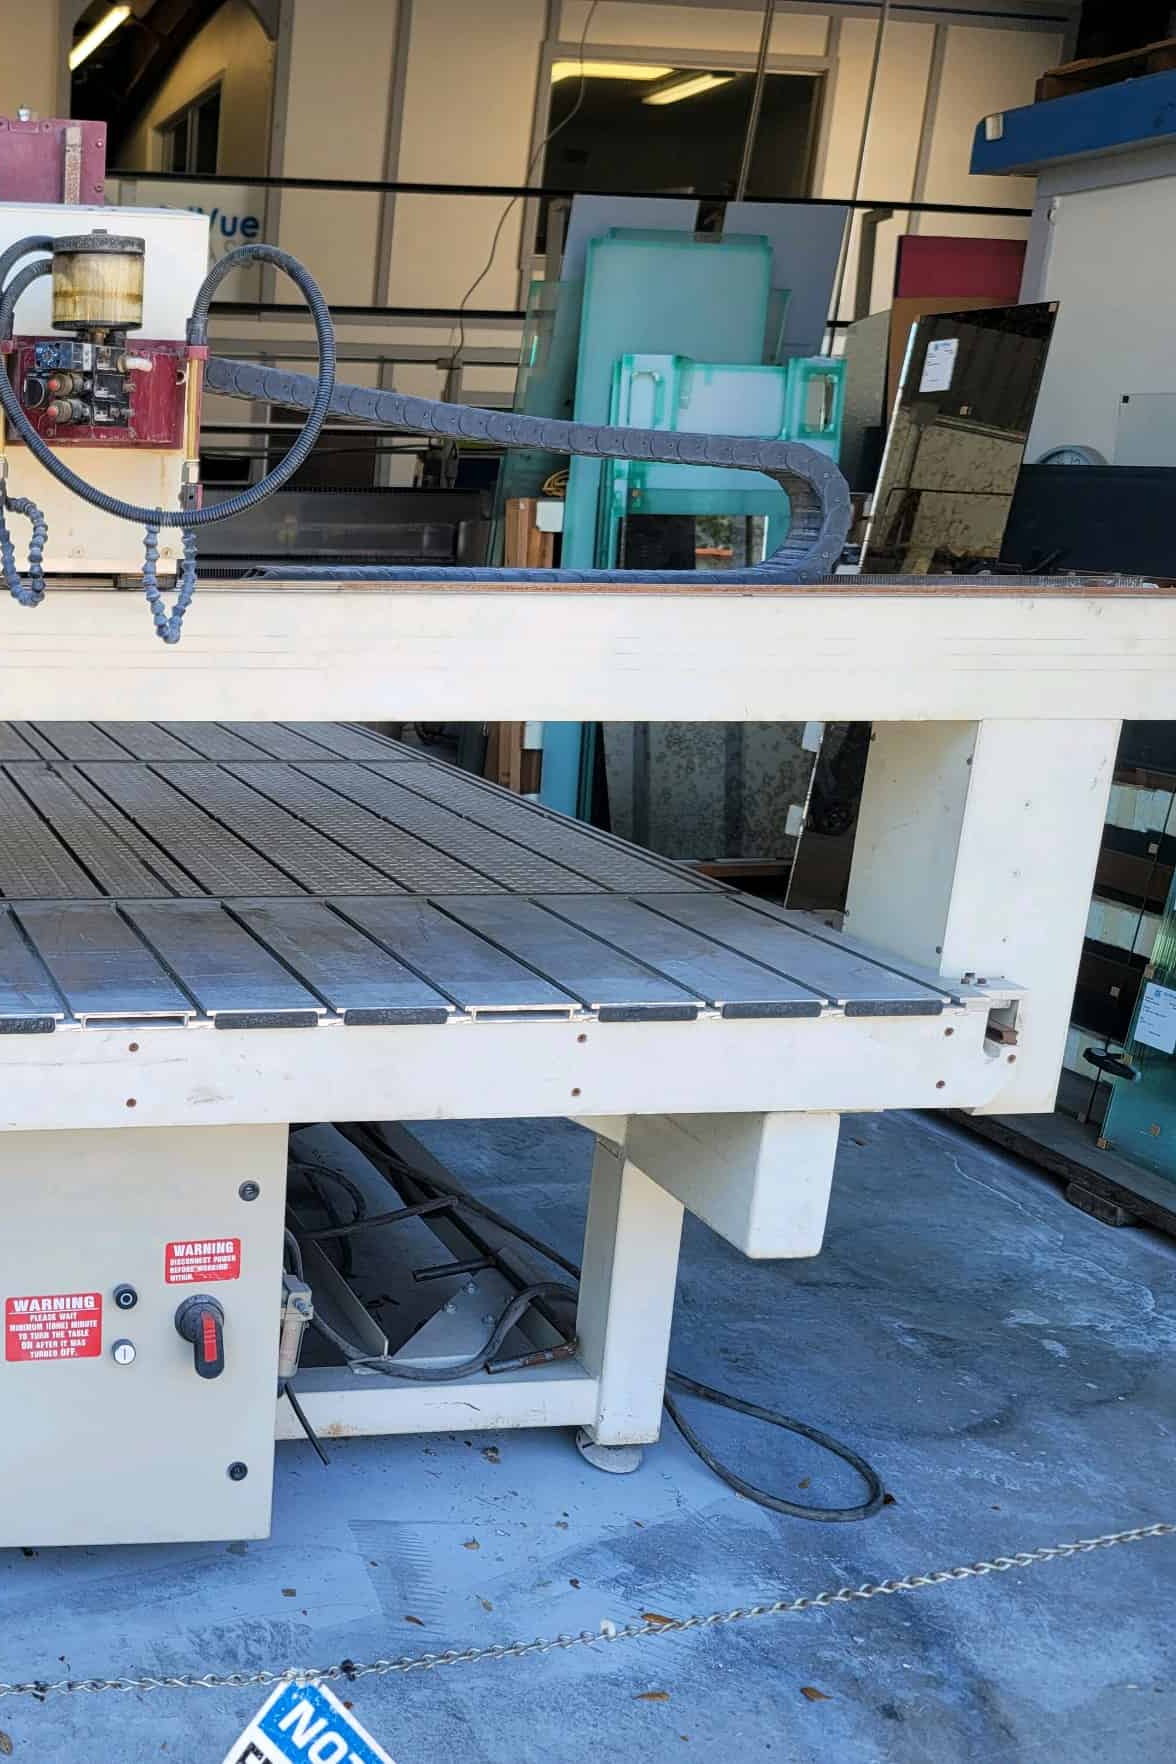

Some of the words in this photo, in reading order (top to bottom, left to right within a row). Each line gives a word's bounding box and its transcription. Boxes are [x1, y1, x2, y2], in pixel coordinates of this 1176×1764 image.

[173, 1241, 234, 1257] WARNING
[213, 1254, 237, 1263] POWER
[13, 1296, 95, 1313] WARNING
[30, 1313, 57, 1322] PLEASE
[59, 1311, 77, 1320] WAIT
[9, 1322, 43, 1332] MINIMUM
[71, 1320, 97, 1329] MINUTE
[18, 1332, 28, 1340] TO
[30, 1331, 50, 1340] TURN
[52, 1330, 65, 1339] THE
[68, 1329, 89, 1338] TABLE
[21, 1341, 33, 1350] ON
[36, 1340, 58, 1349] AFTER
[60, 1339, 68, 1347] IT
[70, 1338, 87, 1347] WAS
[30, 1350, 58, 1359] TURNED
[278, 1699, 365, 1764] NO
